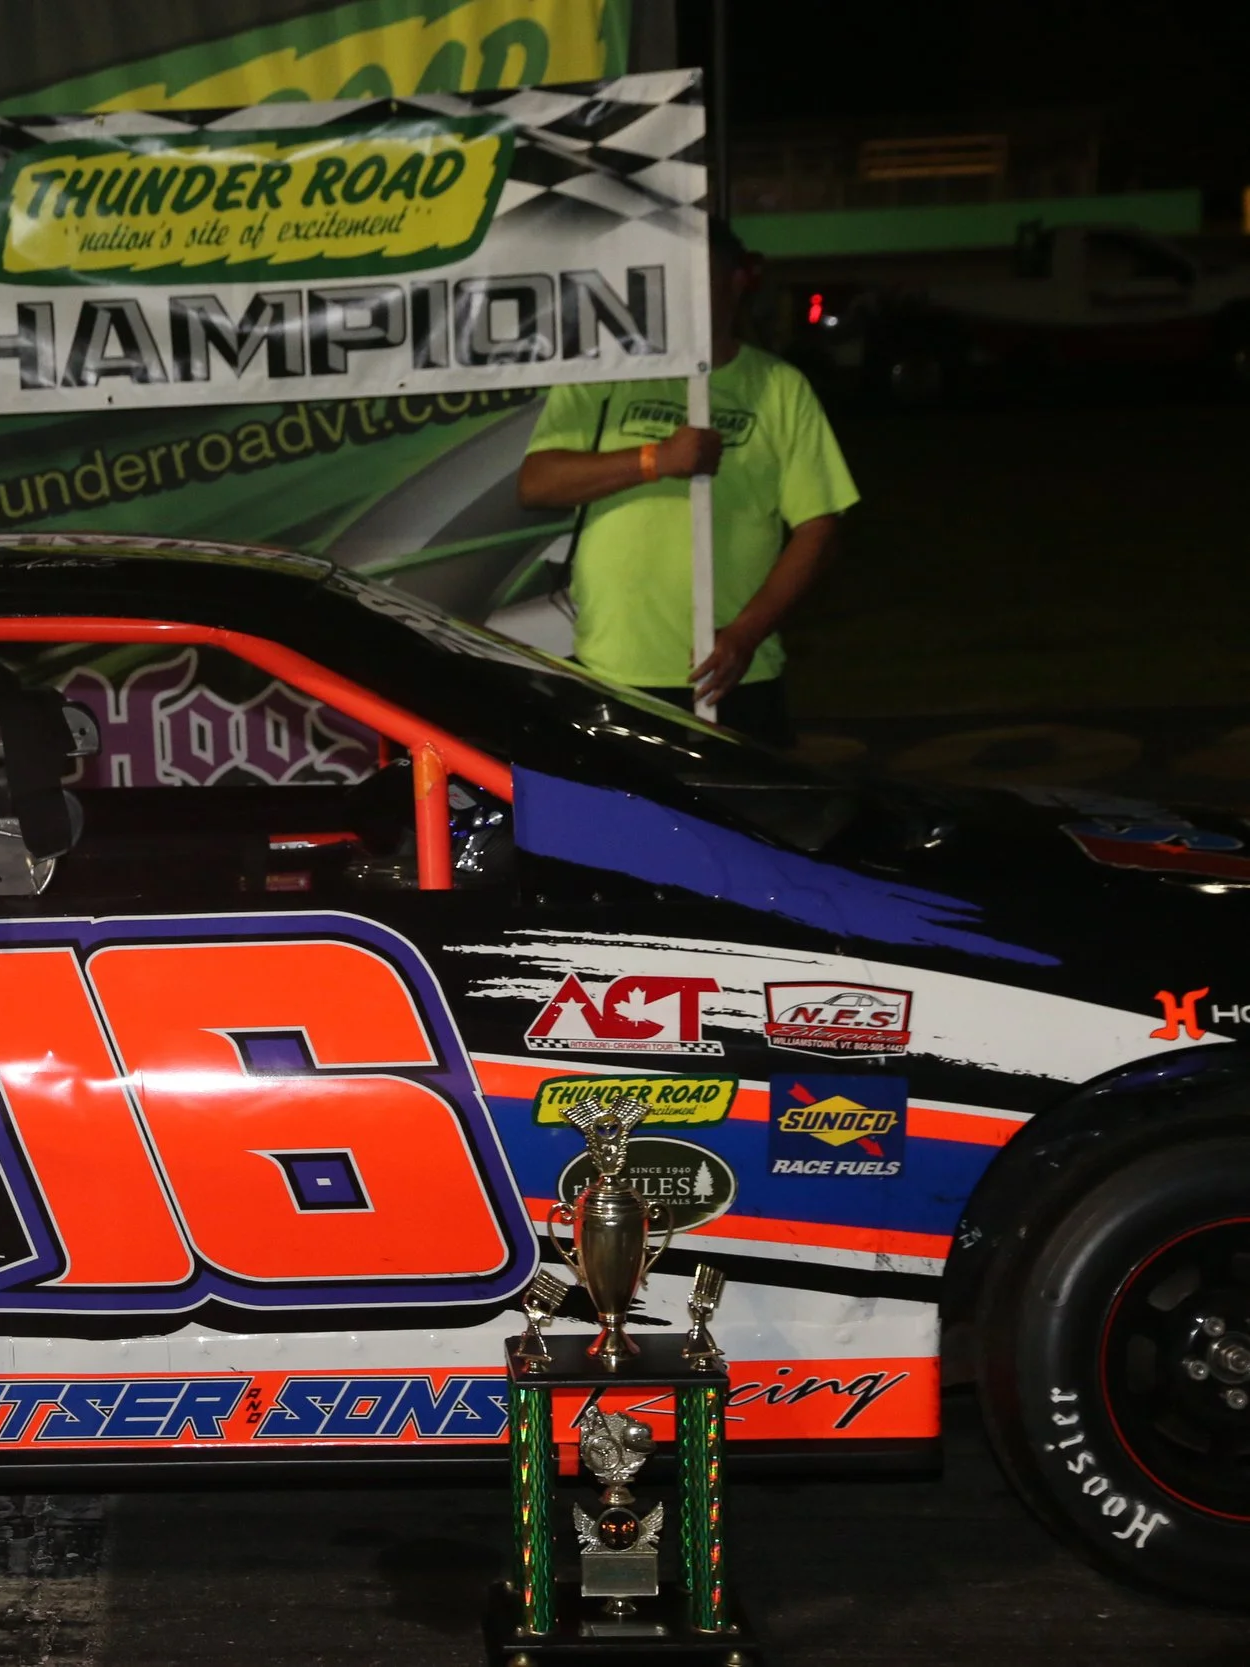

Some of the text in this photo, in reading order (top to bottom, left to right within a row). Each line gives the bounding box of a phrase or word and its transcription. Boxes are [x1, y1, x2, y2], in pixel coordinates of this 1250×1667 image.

[27, 149, 466, 220] THUNDER ROAD
[185, 211, 229, 248] site
[241, 210, 267, 250] of
[527, 973, 720, 1042] ACT
[547, 1084, 720, 1106] THUNDER ROAD
[783, 1110, 892, 1132] SUNOCO
[624, 1177, 692, 1197] ILES
[629, 1166, 692, 1175] SINCE 1940
[771, 1159, 902, 1176] RACE FUELS
[244, 1386, 262, 1425] AND
[253, 1376, 508, 1440] SONS
[570, 1367, 911, 1429] cing
[1043, 1385, 1171, 1549] Hoosier
